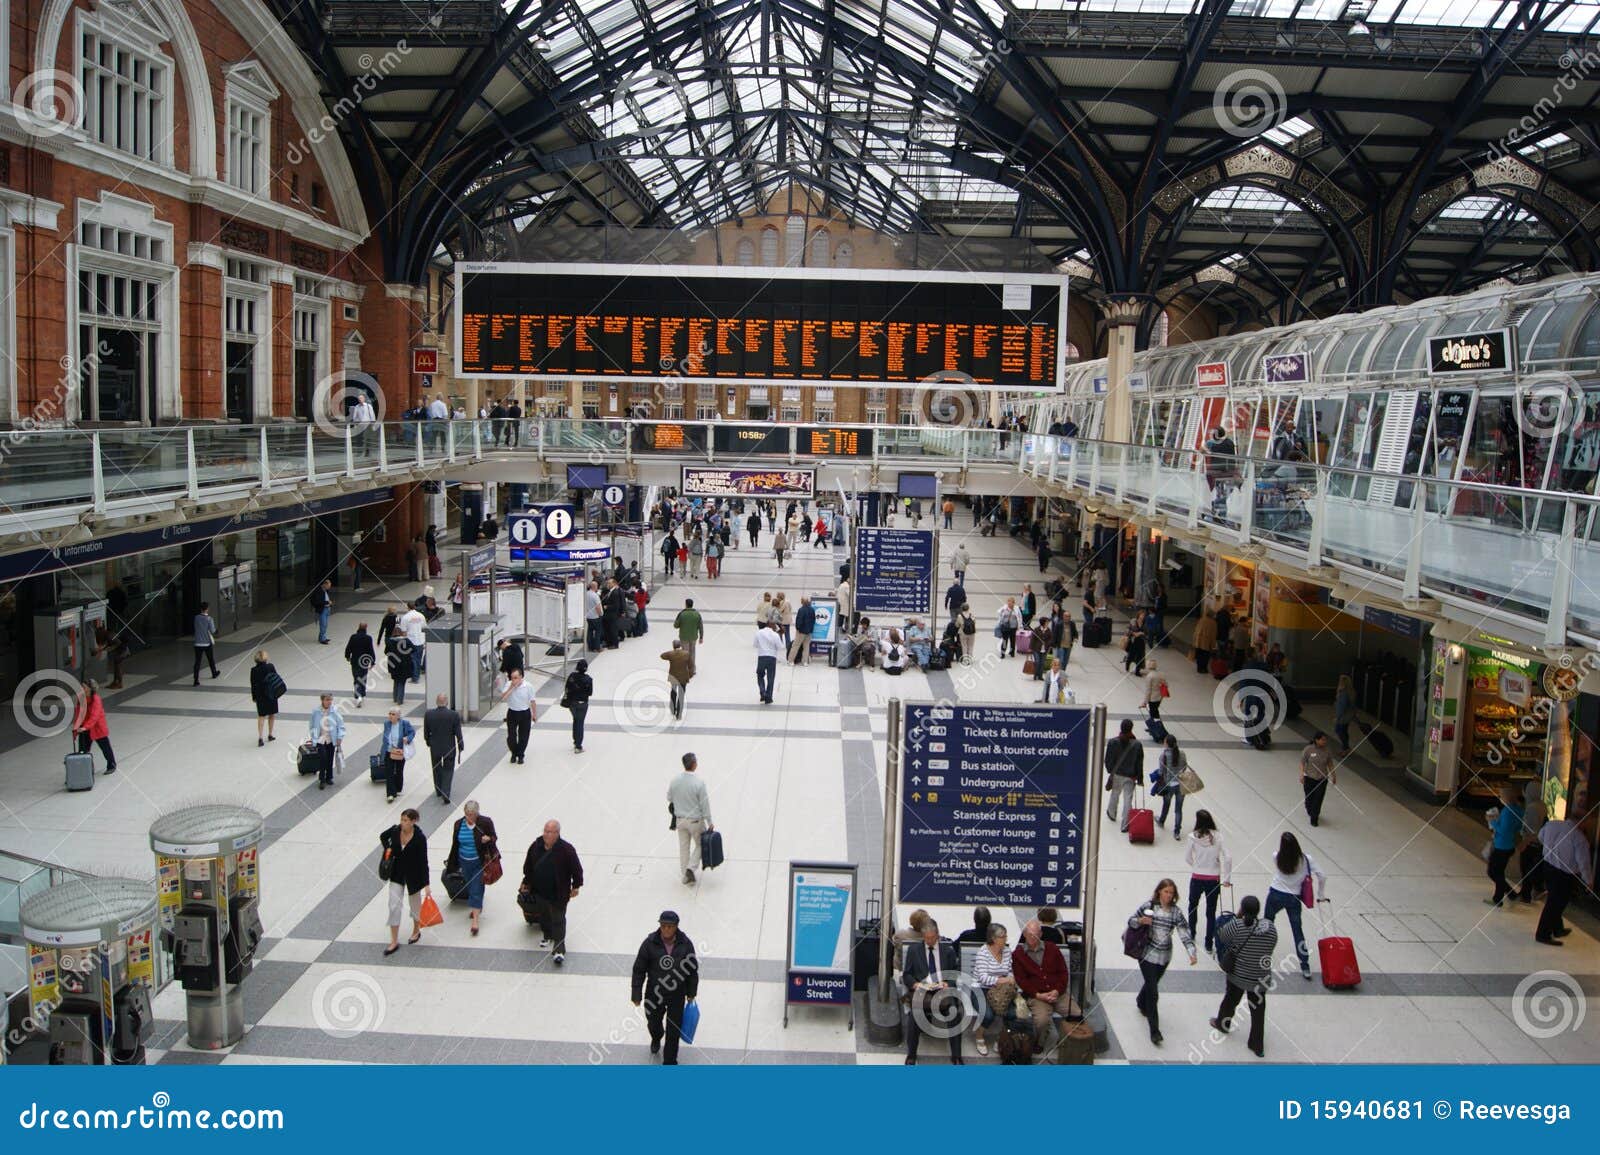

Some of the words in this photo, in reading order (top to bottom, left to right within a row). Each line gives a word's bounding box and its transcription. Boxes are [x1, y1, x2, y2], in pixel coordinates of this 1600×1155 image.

[1442, 339, 1491, 364] claire's
[686, 478, 700, 492] 60
[64, 541, 103, 557] Information
[569, 550, 607, 559] Information
[963, 710, 980, 720] Lift
[963, 727, 998, 738] Tickets
[1000, 728, 1008, 738] &
[1011, 728, 1068, 740] information
[963, 744, 991, 754] Travel
[994, 745, 1002, 754] &
[1003, 745, 1035, 755] tourist
[1038, 747, 1069, 756] centre
[961, 761, 979, 770] Bus
[981, 761, 1015, 771] station
[961, 778, 1024, 790] Underground
[961, 794, 983, 806] Way
[986, 795, 1003, 804] out
[953, 810, 996, 821] Stansted
[998, 811, 1036, 822] Express
[954, 827, 1001, 837] Customer
[1003, 828, 1036, 839] lounge
[981, 844, 1007, 855] Cycle
[1010, 845, 1035, 854] store
[950, 859, 971, 869] First
[973, 860, 999, 870] Class
[1001, 861, 1034, 872] lounge
[973, 876, 993, 885] Left
[995, 877, 1033, 888] luggage
[1008, 893, 1032, 903] Taxis
[806, 977, 846, 988] Liverpool
[806, 989, 833, 999] Street
